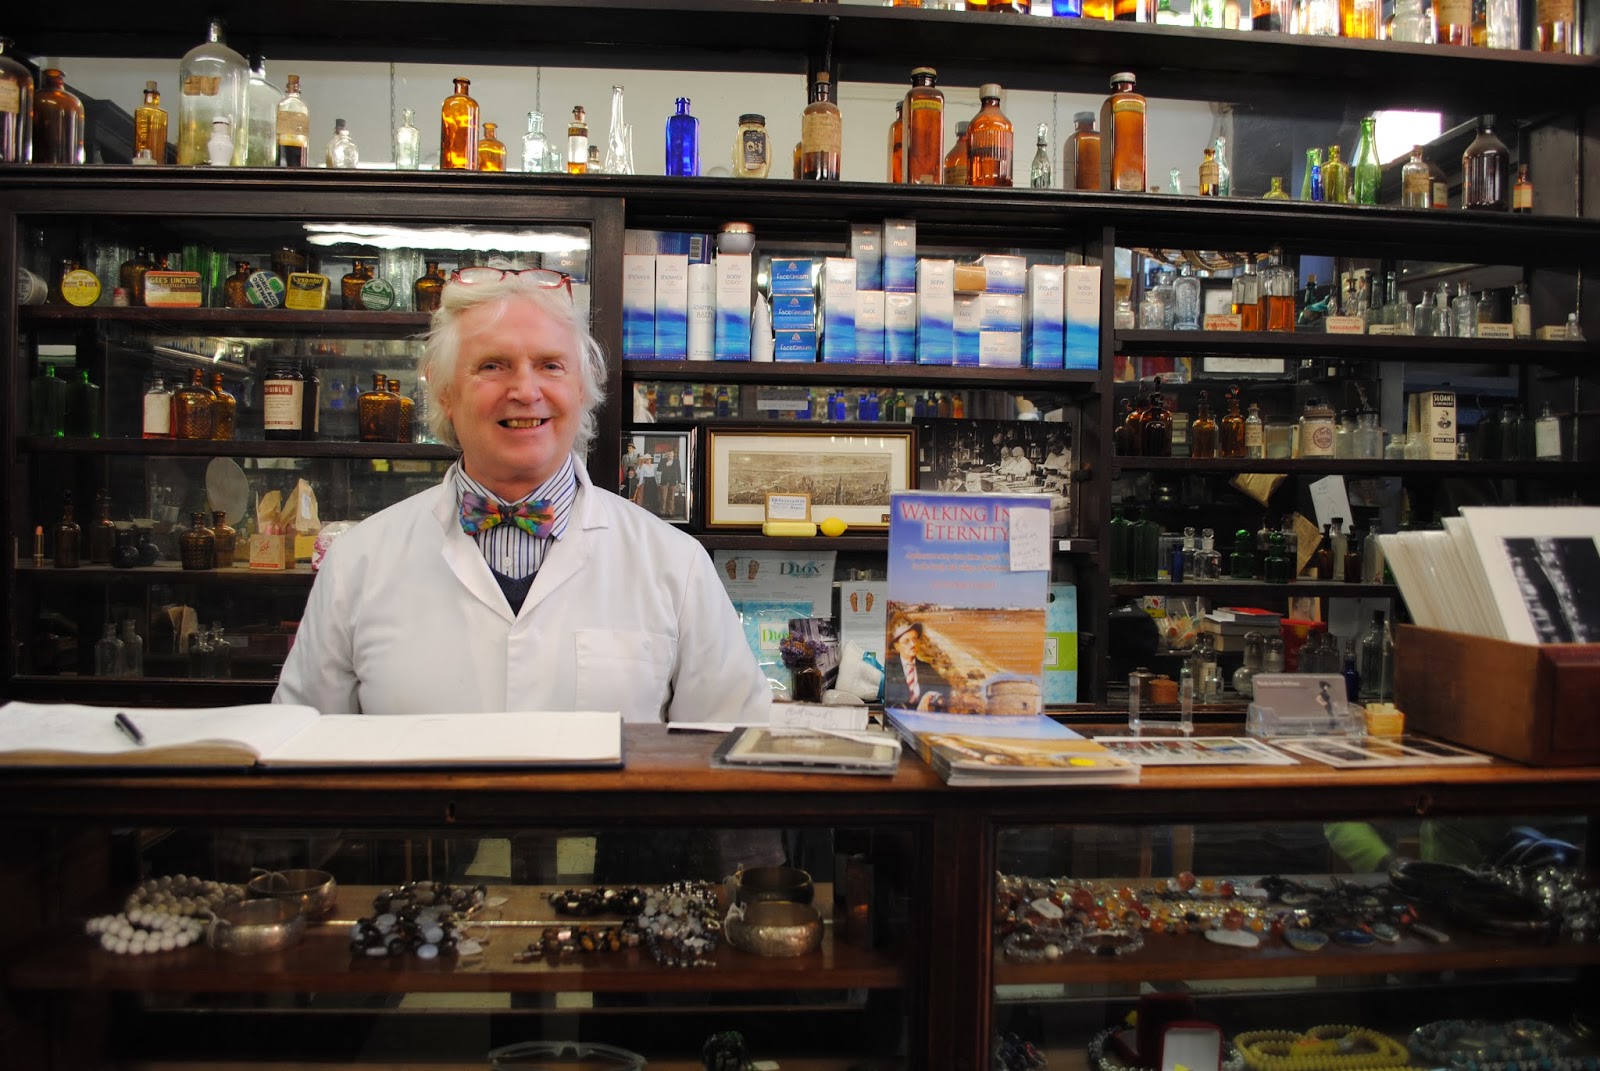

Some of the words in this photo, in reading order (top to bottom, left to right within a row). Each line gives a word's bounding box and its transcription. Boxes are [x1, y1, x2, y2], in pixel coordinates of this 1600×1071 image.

[252, 277, 272, 307] OINTMENT
[901, 503, 988, 522] WALKING
[925, 523, 1010, 541] ETERNITY
